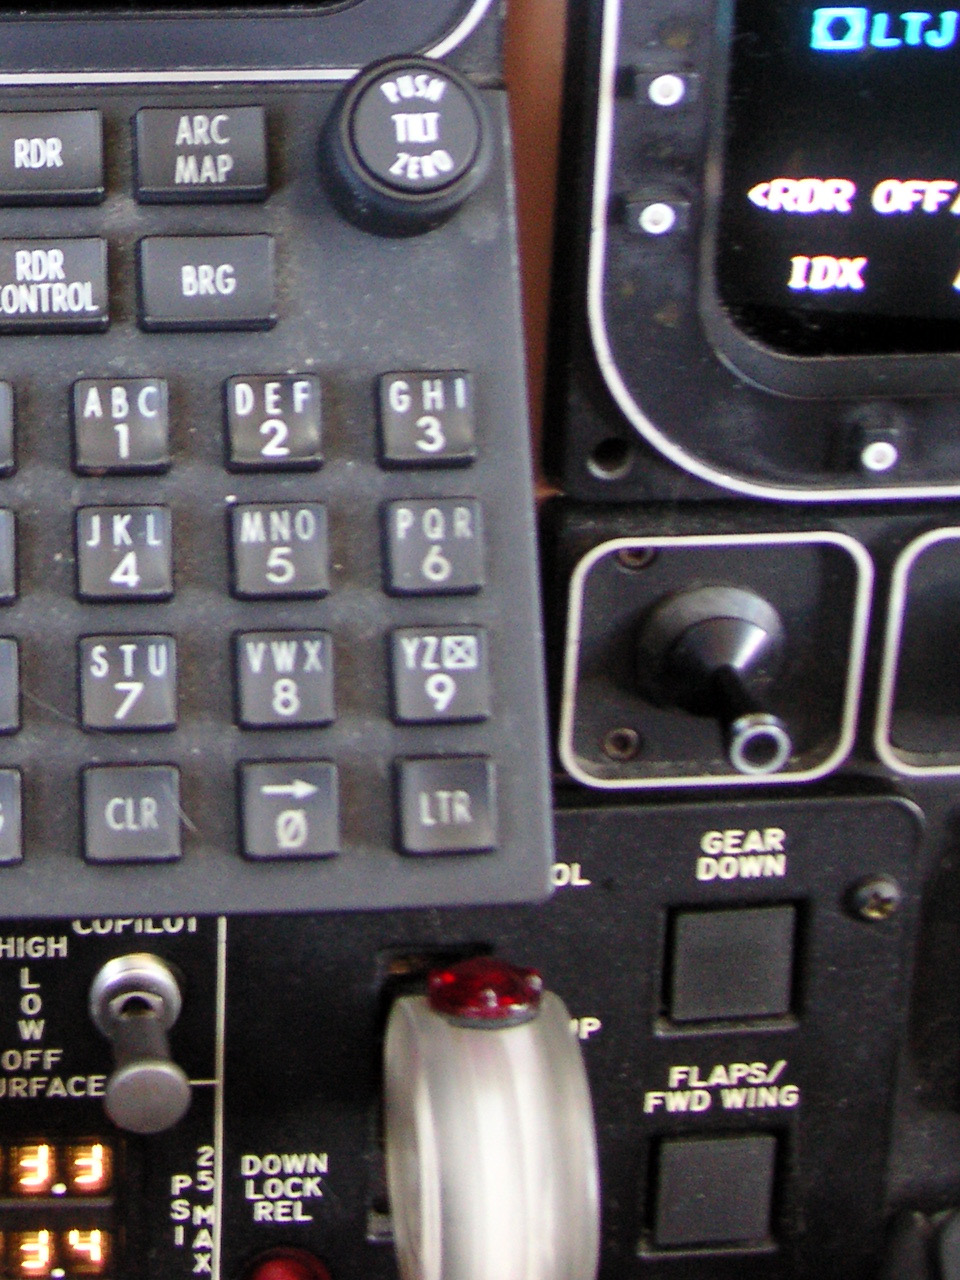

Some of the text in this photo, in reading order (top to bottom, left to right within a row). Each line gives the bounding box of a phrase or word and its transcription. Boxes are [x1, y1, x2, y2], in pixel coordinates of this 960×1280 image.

[380, 74, 447, 105] PUSH
[176, 115, 230, 146] ARC
[391, 111, 441, 144] TILT
[14, 137, 63, 169] RDR
[388, 148, 455, 180] ZERO
[175, 155, 234, 185] MAP
[15, 249, 65, 280] RDR
[181, 264, 237, 297] BRG
[788, 256, 868, 291] IDX
[112, 422, 130, 459] 1
[259, 419, 290, 457] 2
[415, 416, 446, 453] 3
[109, 552, 141, 588] 4
[266, 547, 296, 584] 5
[422, 545, 451, 582] 6
[113, 682, 144, 720] 7
[271, 677, 300, 716] 8
[424, 673, 456, 711] 9
[104, 797, 159, 831] CLR
[418, 791, 473, 826] LTR
[701, 827, 787, 855] GEAR
[696, 854, 788, 881] DOWN
[1, 1049, 63, 1071] OFF
[668, 1060, 787, 1088] FLAPS/
[644, 1083, 800, 1115] FWD WING
[241, 1152, 329, 1178] DOWN
[245, 1175, 323, 1201] LOCK
[253, 1200, 312, 1224] REL
